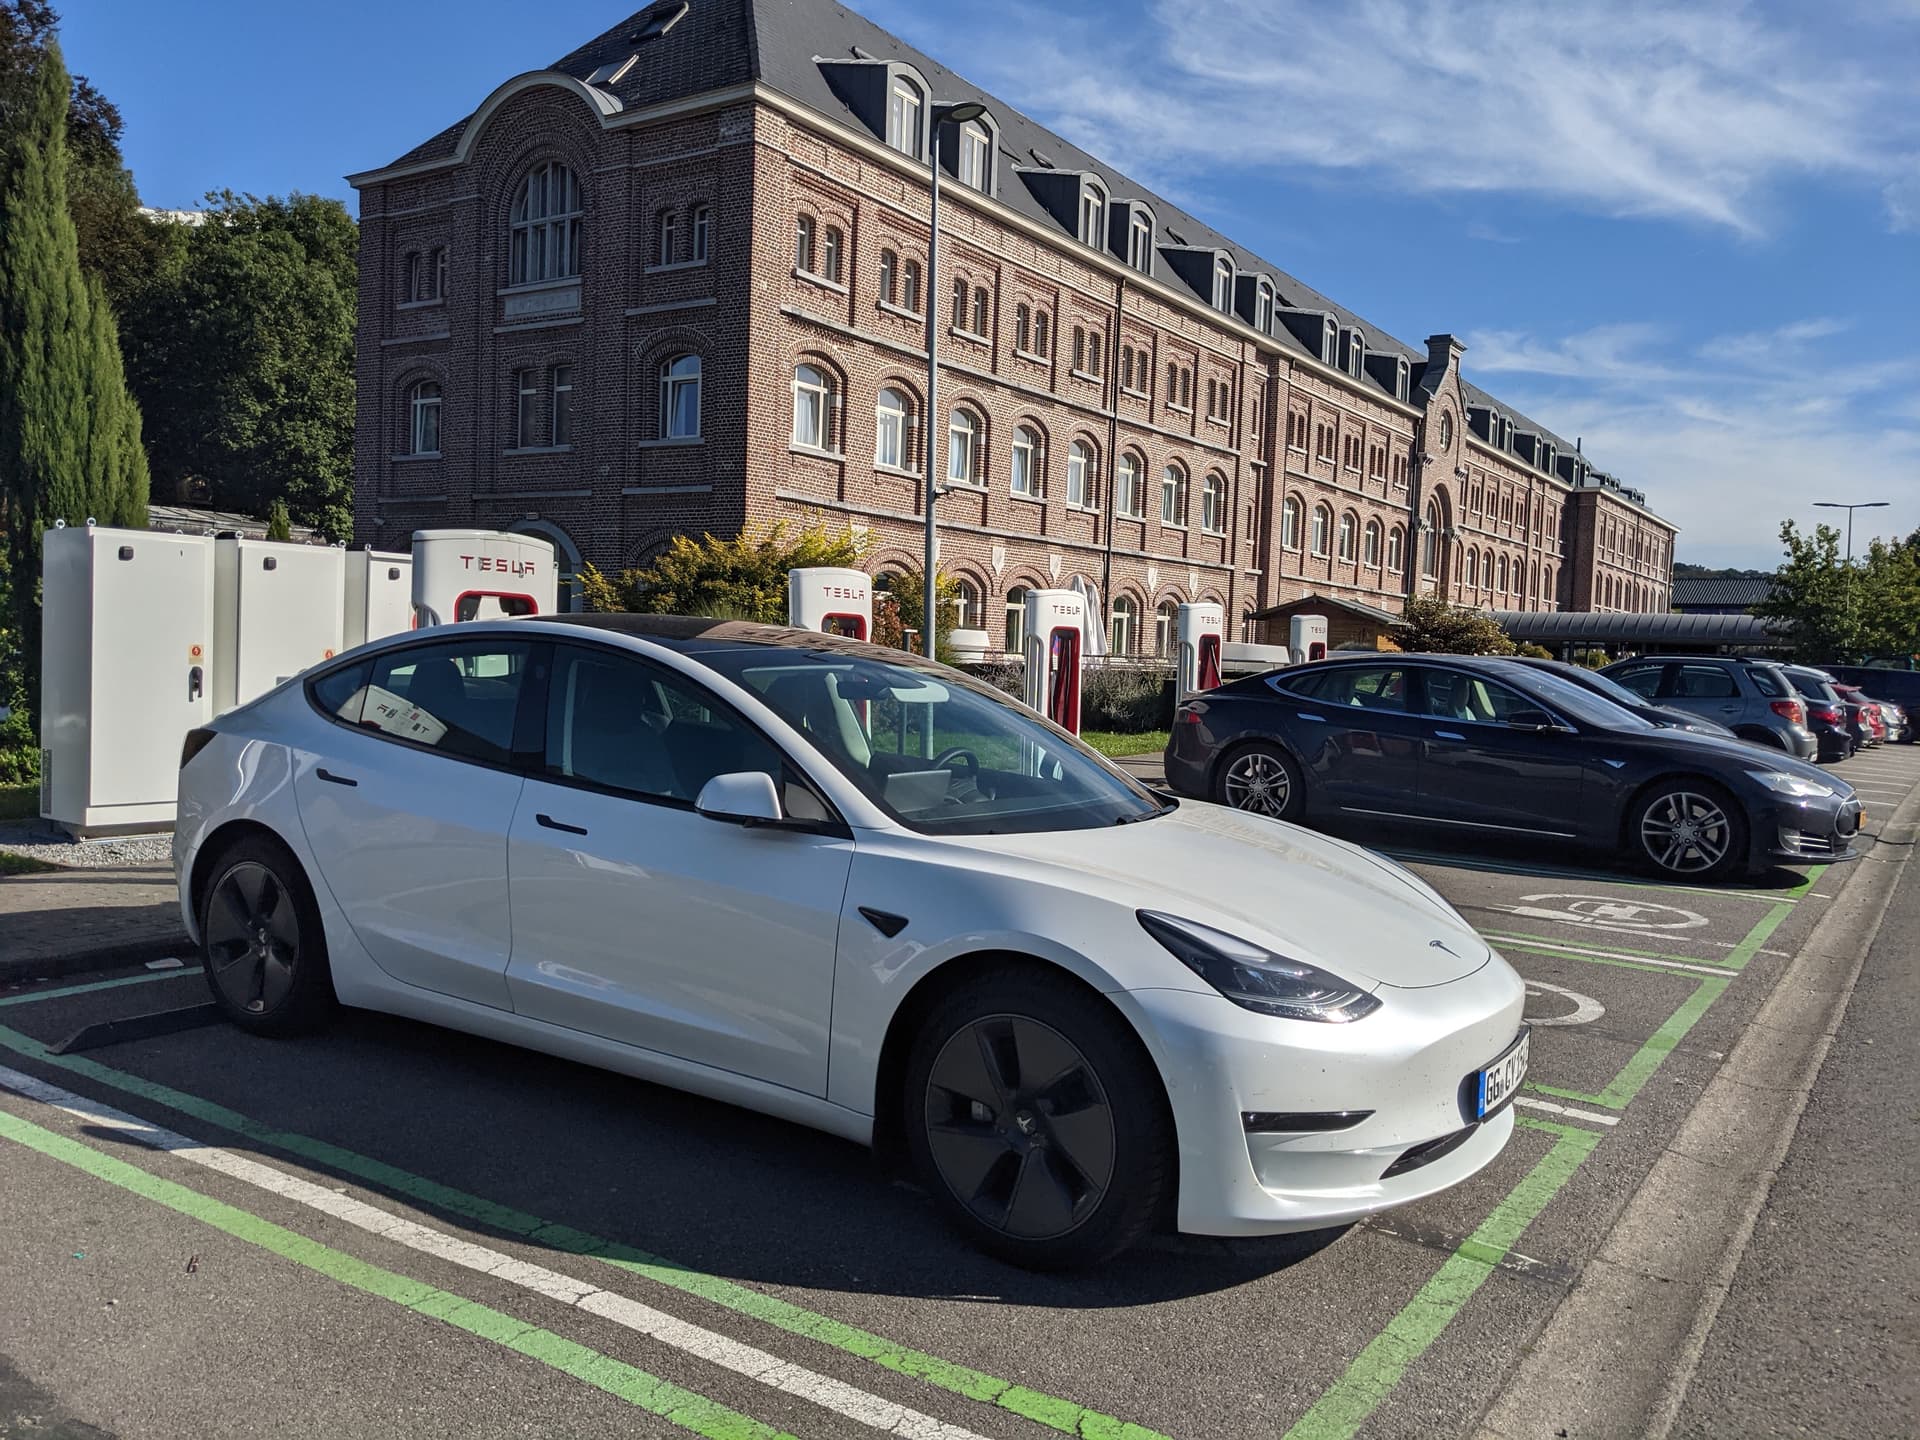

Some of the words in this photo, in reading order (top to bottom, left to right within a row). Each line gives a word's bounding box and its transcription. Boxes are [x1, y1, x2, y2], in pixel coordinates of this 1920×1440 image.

[460, 555, 535, 576] TESLA
[823, 586, 865, 600] TESLA
[1052, 604, 1081, 615] TESLA
[1486, 1067, 1500, 1106] GG
